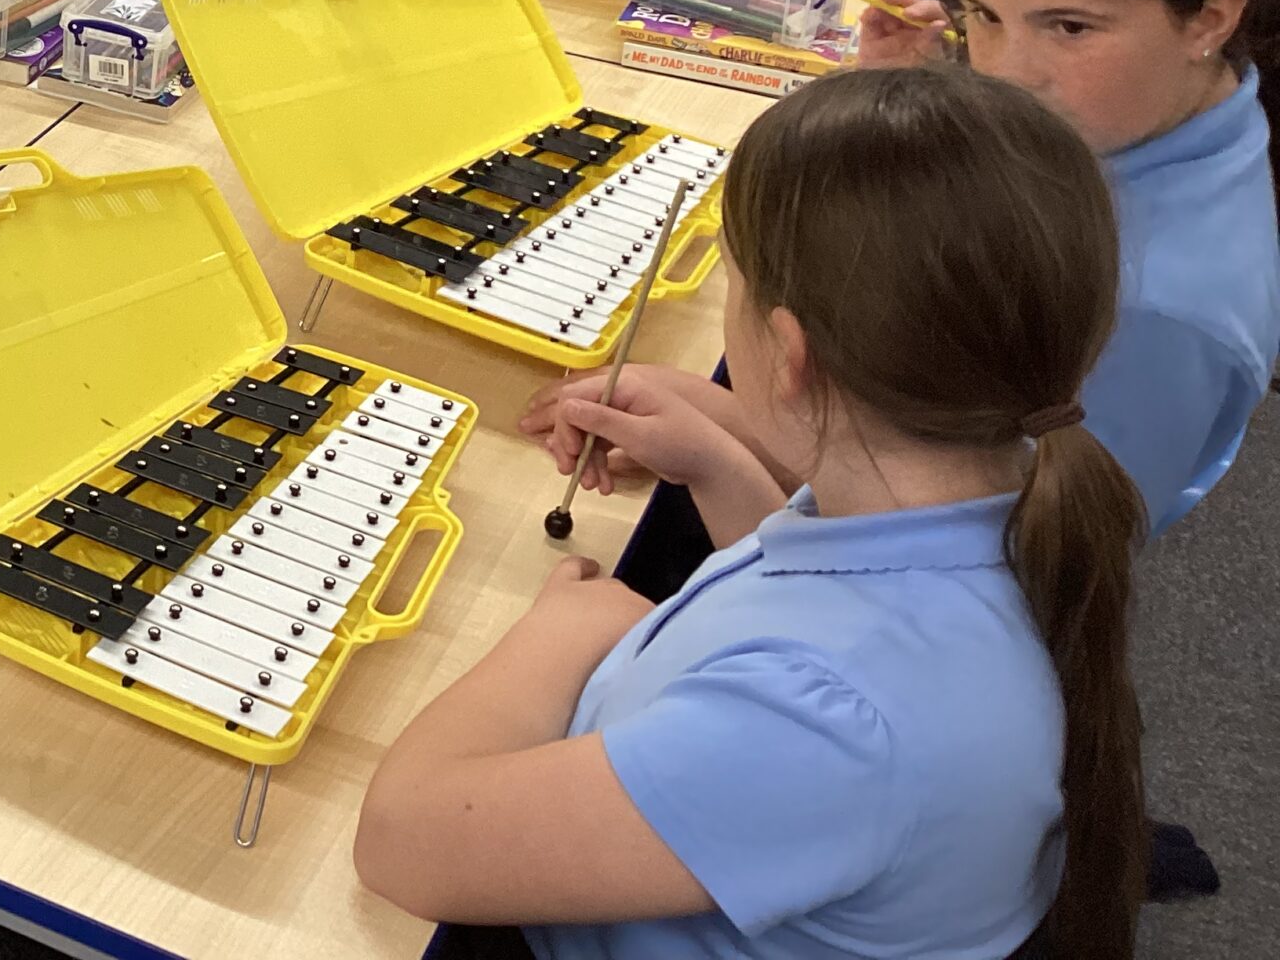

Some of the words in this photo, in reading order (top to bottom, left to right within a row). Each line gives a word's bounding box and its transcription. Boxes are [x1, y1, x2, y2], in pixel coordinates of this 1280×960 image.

[661, 57, 685, 70] DAD
[696, 65, 718, 76] END
[731, 69, 782, 89] RAINBOW
